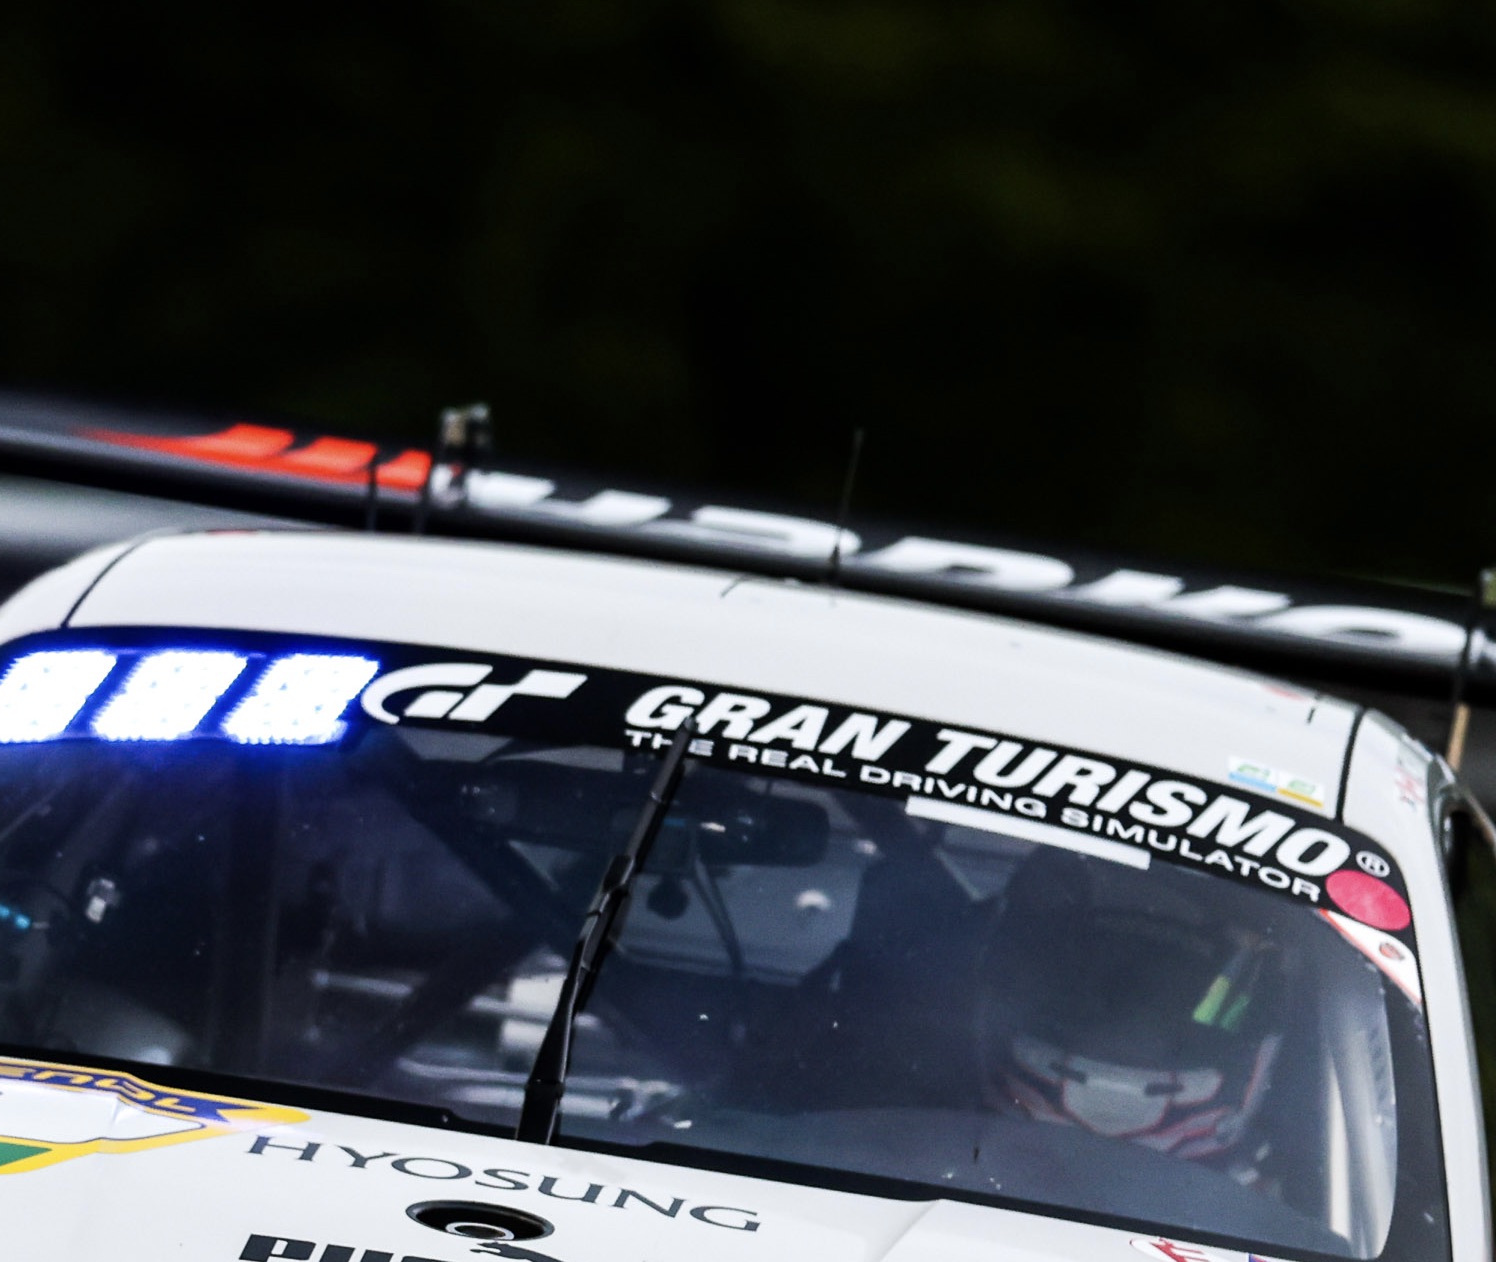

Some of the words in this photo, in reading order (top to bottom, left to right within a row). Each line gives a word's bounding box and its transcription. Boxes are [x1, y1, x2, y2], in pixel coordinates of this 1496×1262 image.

[624, 686, 912, 762] GRAN
[925, 729, 1350, 876] TURISMO
[728, 747, 845, 780] REAL
[859, 766, 1047, 819] DRIVING
[1060, 807, 1320, 902] SIMULATOR
[247, 1134, 763, 1232] HYOSUNG
